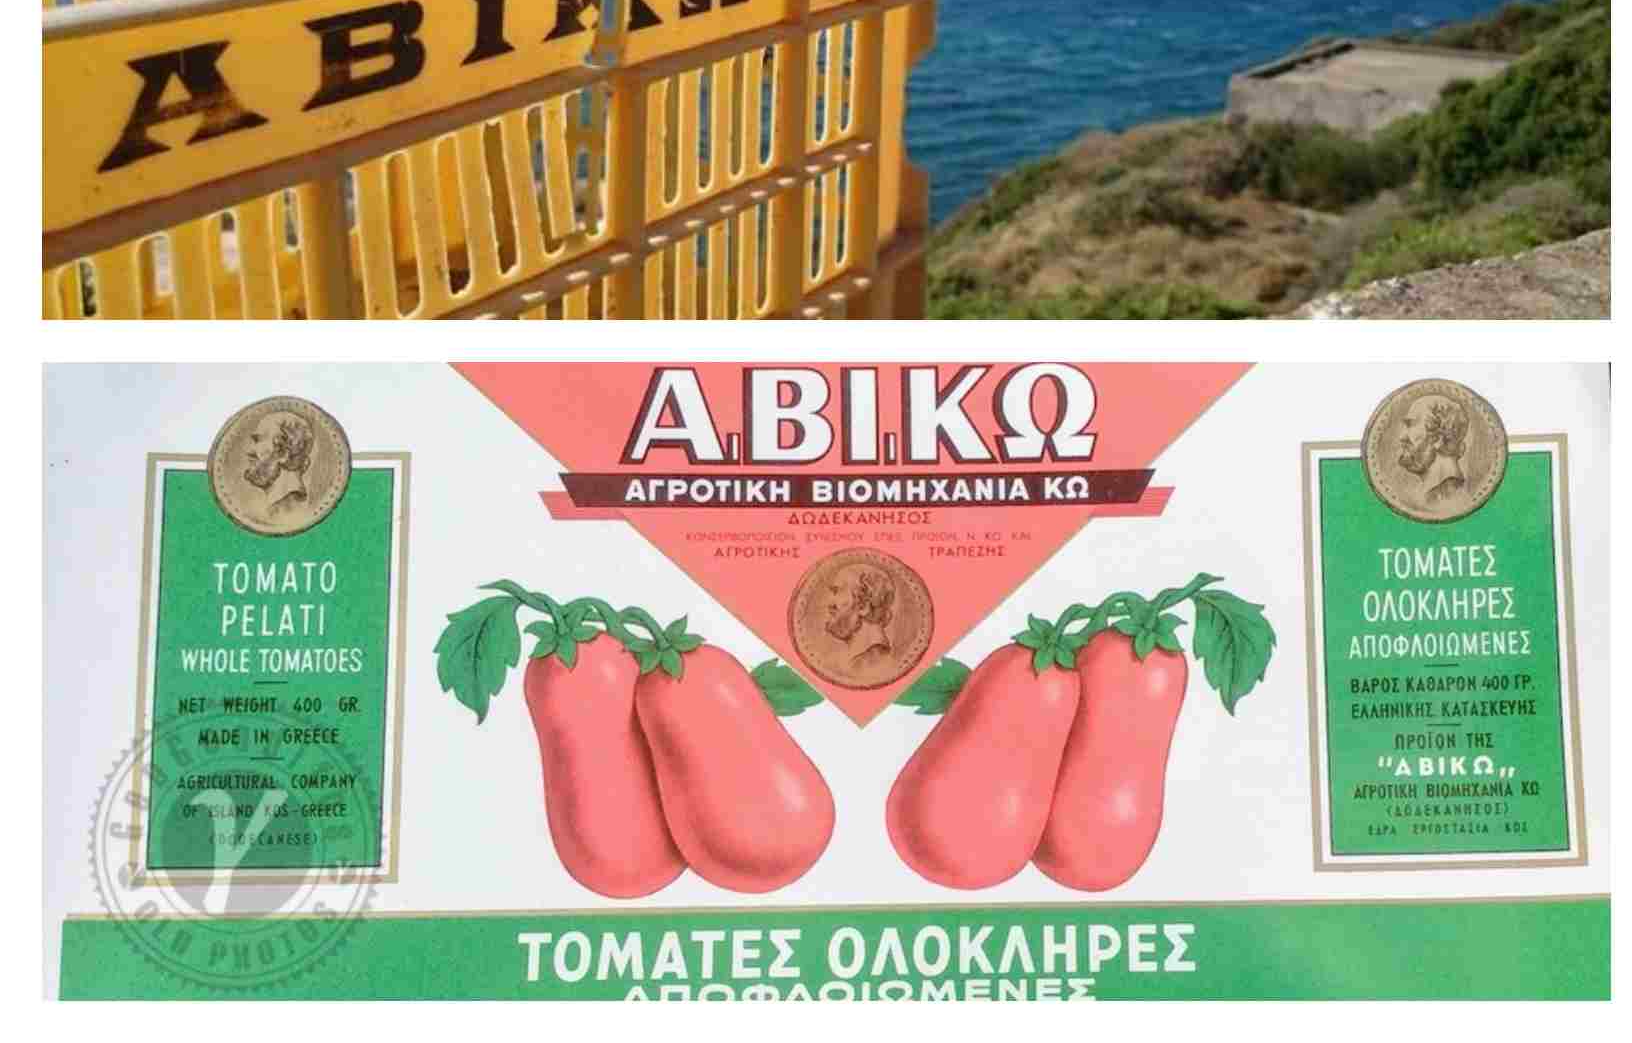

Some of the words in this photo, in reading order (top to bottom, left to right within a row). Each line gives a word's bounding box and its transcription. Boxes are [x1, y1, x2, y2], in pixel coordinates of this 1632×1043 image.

[624, 479, 791, 503] ΑΓΡΟΤΙΚΗ
[812, 477, 1030, 503] ΒΙΟΜΗΧΑΝΙΑ
[1044, 475, 1090, 500] ΚΩ
[787, 511, 932, 526] ΔΩΔΕΚΑΝΗΣΟΣ
[713, 547, 801, 558] ΑΓΡΟΤΙΚΗΣ
[928, 545, 1008, 558] ΤΡΑΠΕΖΗΣ
[1379, 546, 1497, 580] ΤΟΜΑΤΕΣ
[214, 561, 337, 594] TOMATO
[1363, 588, 1516, 623] ΟΛΟΚΛΗΡΕΣ
[222, 604, 326, 636] PELATI
[1349, 631, 1531, 660] ΑΠΟΦΛΟΙΩΜΕΝΕΣ
[182, 648, 249, 673] WHOLE
[261, 647, 363, 674] TOMATOES
[1351, 677, 1400, 694] ΒΑΡΟΣ
[1406, 676, 1477, 693] ΚΑΘΑΡΟΝ
[1482, 675, 1510, 691] 400
[178, 697, 207, 715] NET
[223, 697, 277, 714] WEIGHT
[293, 697, 322, 713] 400
[1351, 702, 1434, 720] ΕΛΛΗΝΙΚΗΣ
[1442, 699, 1537, 718] ΚΑΤΑΣΚΕΥΗΣ
[198, 729, 241, 746] MADE
[254, 729, 270, 744] IN
[282, 727, 340, 745] GREECE
[1466, 733, 1495, 749] ΤΗΣ
[177, 774, 276, 790] AGRICULTURAL
[291, 773, 357, 789] COMPANY
[1353, 784, 1417, 800] ΑΓΡΟΤΙΚΗ
[1426, 781, 1514, 799] ΒΙΟΜΗΧΑΝΙΑ
[182, 804, 198, 819] OF
[517, 929, 802, 982] ΤΟΜΑΤΕΣ
[827, 923, 1197, 977] ΟΛΟΚΛΗΡΕΣ
